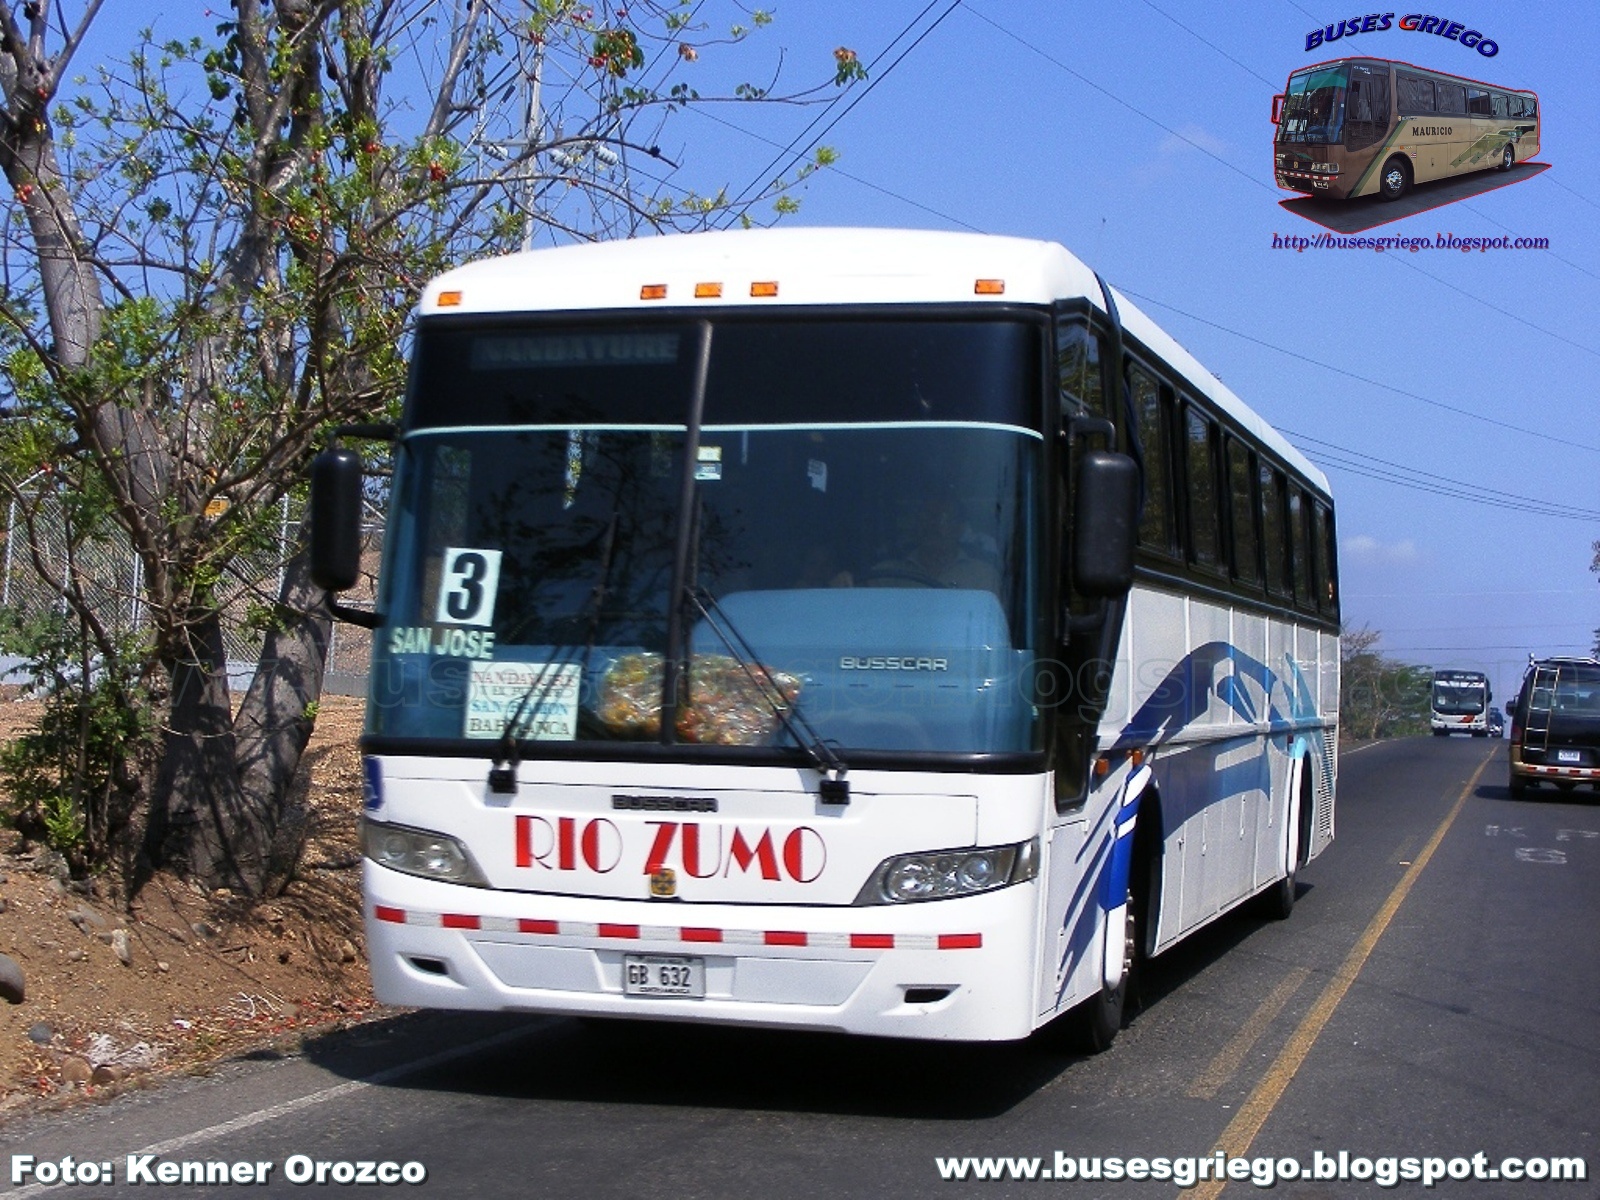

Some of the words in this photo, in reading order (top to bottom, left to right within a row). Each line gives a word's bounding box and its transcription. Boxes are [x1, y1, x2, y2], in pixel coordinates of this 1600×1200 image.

[446, 552, 488, 620] 3
[389, 627, 432, 655] SAN
[434, 629, 496, 660] JOSE
[840, 655, 948, 672] BUSSCAR
[612, 795, 718, 812] BUSSCAR
[515, 815, 623, 873] RIO
[643, 821, 827, 883] ZUMO
[628, 965, 649, 985] GB
[660, 966, 692, 987] 632
